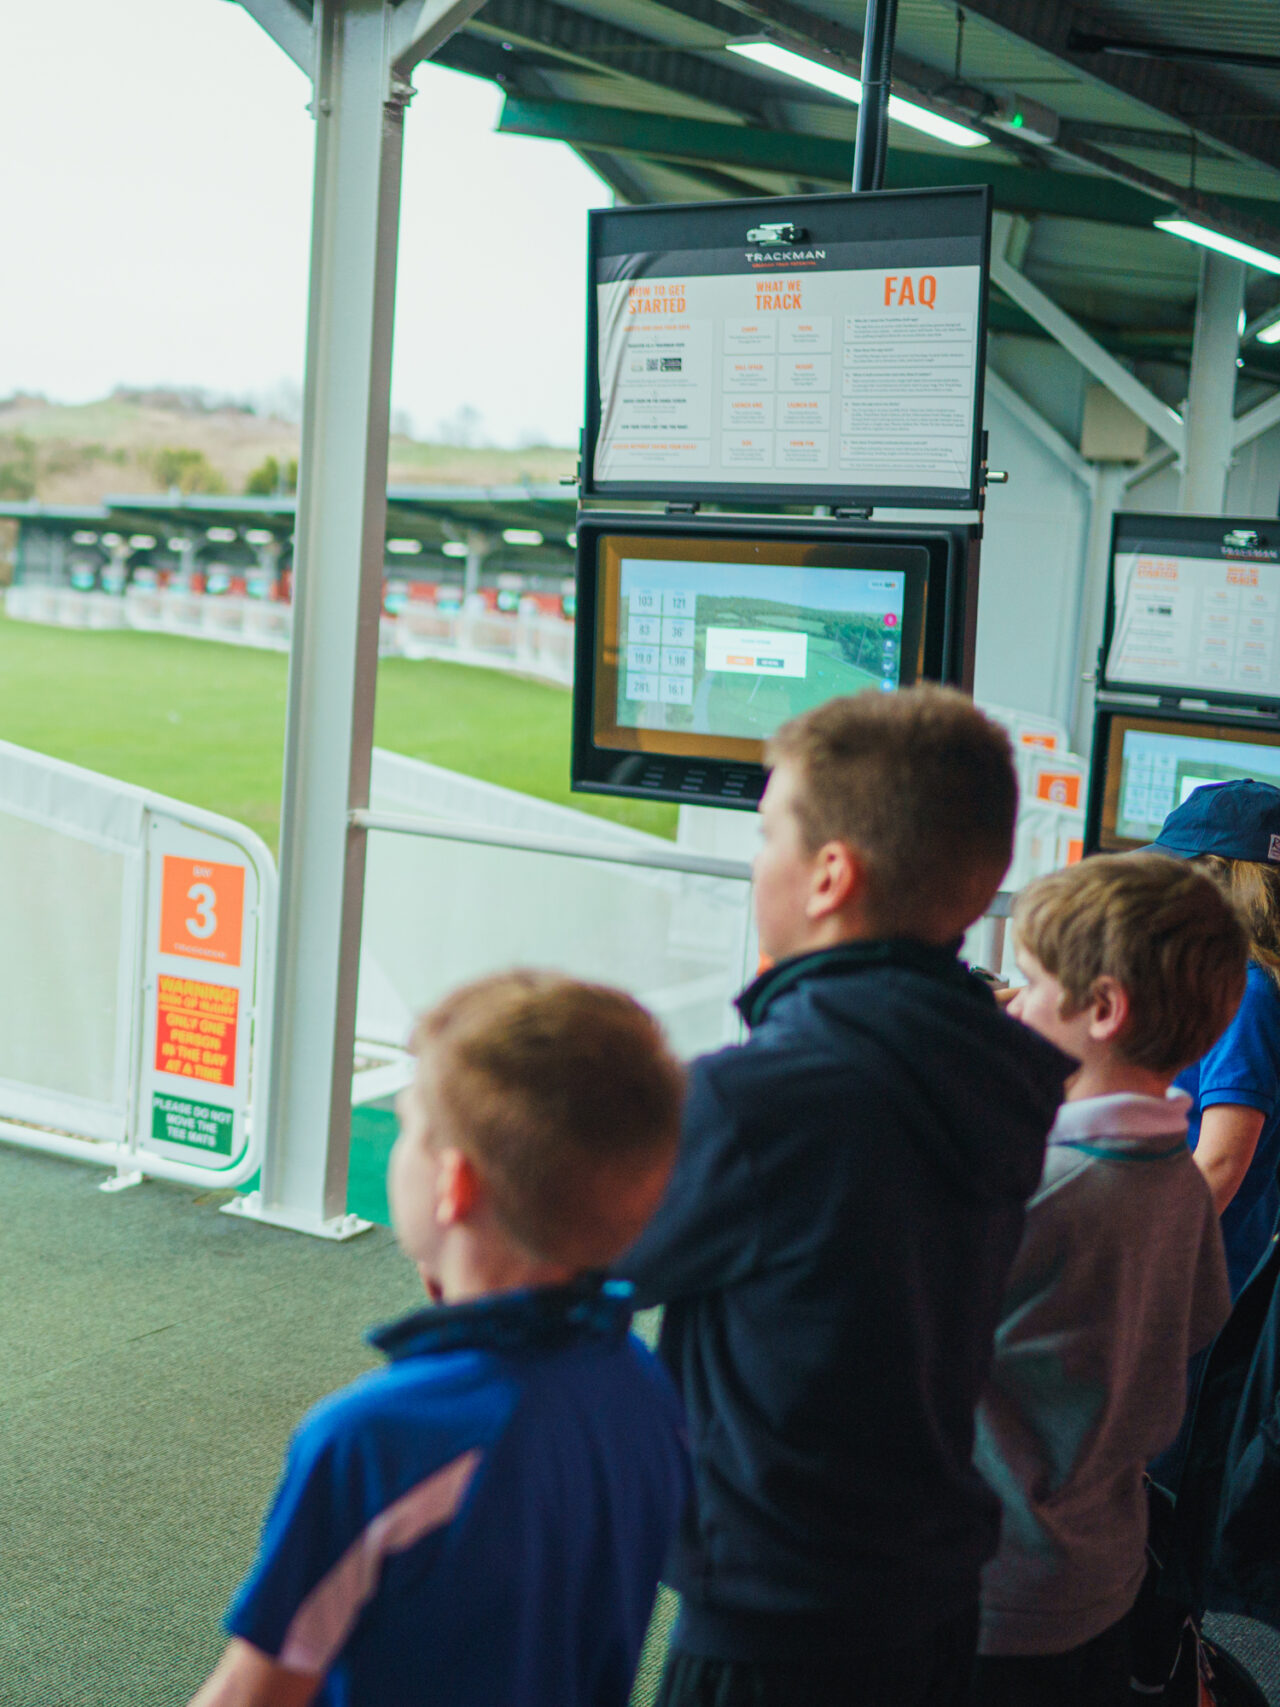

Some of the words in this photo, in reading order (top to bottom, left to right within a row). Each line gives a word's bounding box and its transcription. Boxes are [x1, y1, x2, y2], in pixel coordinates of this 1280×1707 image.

[745, 250, 826, 262] TRACKMAN
[654, 285, 665, 296] TO
[669, 284, 686, 296] GET
[756, 280, 783, 292] WHAT
[787, 280, 802, 291] WE
[884, 274, 937, 310] FAQ
[629, 298, 686, 314] STARTED
[755, 294, 802, 310] TRACK
[192, 865, 213, 878] BAY
[185, 882, 217, 939] 3
[160, 977, 237, 1004] WARNING!
[166, 1013, 197, 1030] ONLY
[199, 1019, 226, 1036] ONE
[170, 1028, 221, 1050] PERSON
[177, 1046, 200, 1062] THE
[202, 1050, 228, 1067] BAY
[166, 1059, 181, 1072] AT
[182, 1062, 193, 1075] A
[195, 1064, 223, 1083] TIME
[153, 1097, 192, 1114] PLEASE
[193, 1105, 209, 1119] DO
[211, 1110, 232, 1124] NOT
[166, 1113, 195, 1129] MOVE
[197, 1119, 218, 1134] THE
[167, 1126, 187, 1140] TEE
[187, 1131, 216, 1147] MATS
